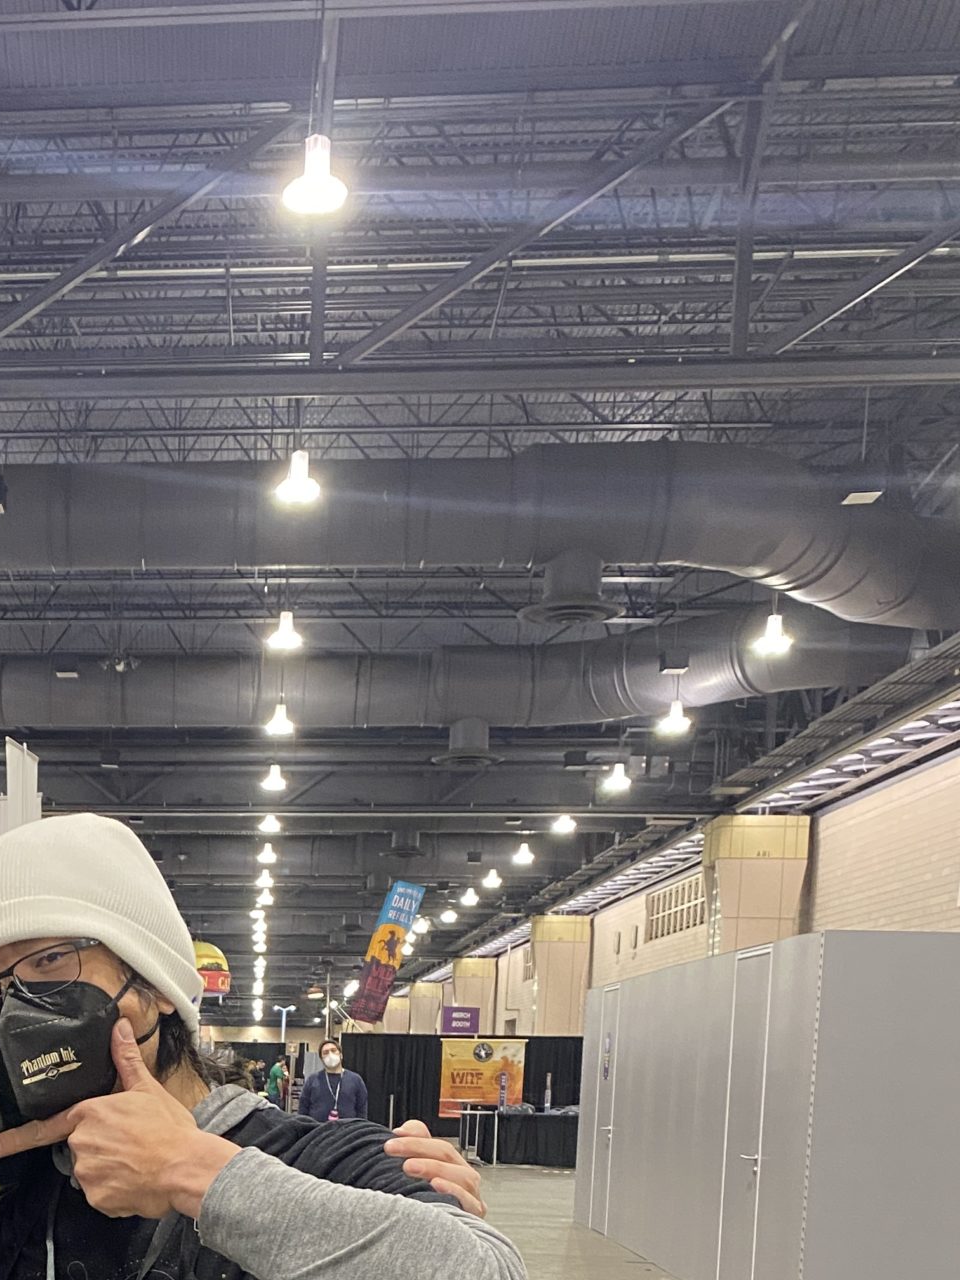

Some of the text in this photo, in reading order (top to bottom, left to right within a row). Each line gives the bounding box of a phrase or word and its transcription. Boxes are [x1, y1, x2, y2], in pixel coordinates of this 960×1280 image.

[392, 894, 417, 912] DAILY
[451, 1020, 471, 1028] BOOTH
[21, 1046, 77, 1077] Phantom Ink
